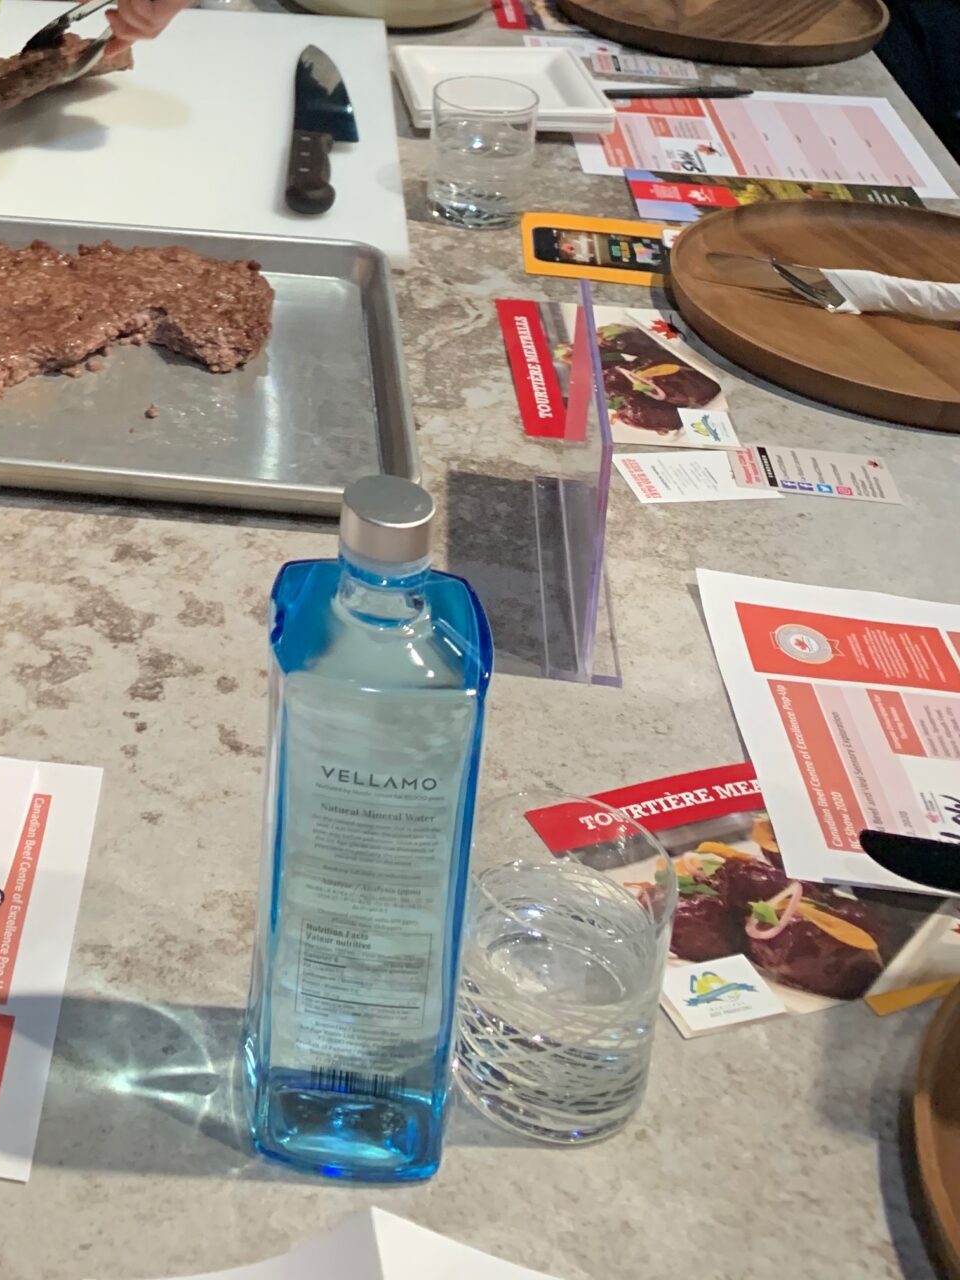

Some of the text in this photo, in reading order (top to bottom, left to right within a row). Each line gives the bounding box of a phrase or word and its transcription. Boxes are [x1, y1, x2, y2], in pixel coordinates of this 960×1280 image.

[515, 316, 551, 417] TOURTIÈRE MEATBALLS
[321, 765, 437, 791] VELLAMO
[776, 684, 843, 846] Canadian Beef Centre of Excellence Pop-Up
[321, 802, 435, 823] Natural Mineral Water
[579, 790, 714, 830] TOURTIÈRE
[830, 791, 847, 811] 2020
[27, 797, 44, 837] Canadian
[842, 813, 857, 836] Show
[22, 839, 35, 860] Beef
[14, 861, 30, 891] Centre
[12, 892, 22, 903] of
[0, 905, 20, 954] Excellence
